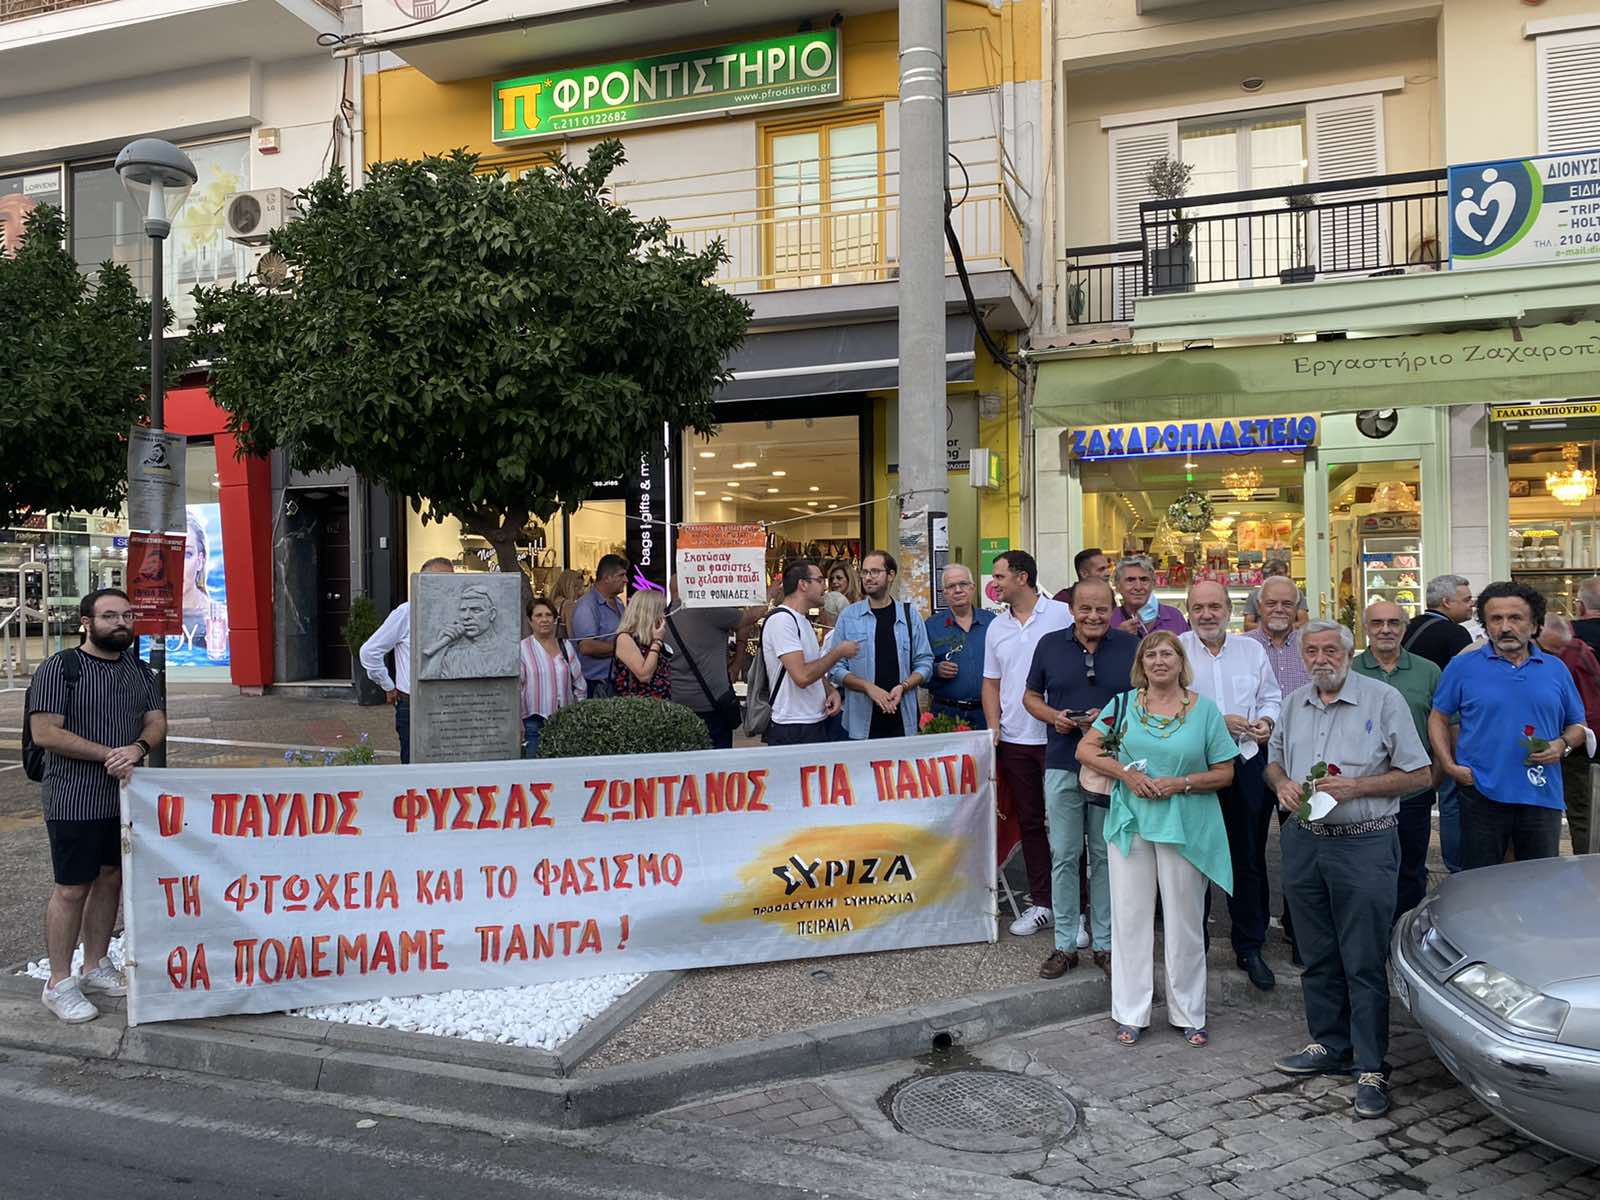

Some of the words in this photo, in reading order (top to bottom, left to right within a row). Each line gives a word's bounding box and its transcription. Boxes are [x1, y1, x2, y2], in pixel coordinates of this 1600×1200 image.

[552, 41, 833, 112] ΦΡΟΝΤΙΣΤΗΡΙΟ
[734, 81, 832, 104] www.pfrodistirio.gr
[582, 111, 628, 126] 0122682
[1560, 234, 1582, 246] 210
[1295, 349, 1453, 376] Εργαστήριο
[1496, 405, 1597, 419] ΓΑΛΑΚΤΟΜΠΟΥΡΙΚΟ
[1071, 414, 1318, 455] ΖΑΧΑΡΟΠΛΑΣΤΕΙΟ
[640, 479, 651, 490] &
[639, 493, 653, 522] gifts
[640, 531, 653, 566] bags
[710, 589, 749, 599] ΦΟΝΙΑΔΕΣ
[210, 790, 363, 838] ΠΑΥΛΟΣ
[393, 782, 555, 833] ΦΥΣΣΑΣ
[581, 767, 772, 823] ΖΩΝΤΑΝΟΣ
[799, 762, 856, 808] ΓΙΑ
[870, 753, 980, 803] ΠΑΝΤΑ
[158, 874, 201, 918] ΤΗ
[224, 869, 400, 916] ΦΤΩΧΕΙΑ
[416, 868, 464, 906] ΚΑΙ
[480, 865, 518, 899] ΤΟ
[533, 852, 683, 897] ΦΑΣΙΣΜΟ
[771, 853, 917, 895] ΣΥΡΙΖΑ
[752, 897, 834, 915] ΠΡΟΟΔΕΥΤΙΚΗ
[843, 891, 915, 907] ΣΥΜΜΑΧΙΑ
[796, 917, 852, 937] ΠΕΙΡΑΙΑ
[166, 943, 211, 991] ΘΑ
[233, 928, 450, 987] ΠΟΛΕΜΑΜΕ
[475, 917, 603, 964] ΠΑΝΤΑ
[617, 914, 631, 950] !
